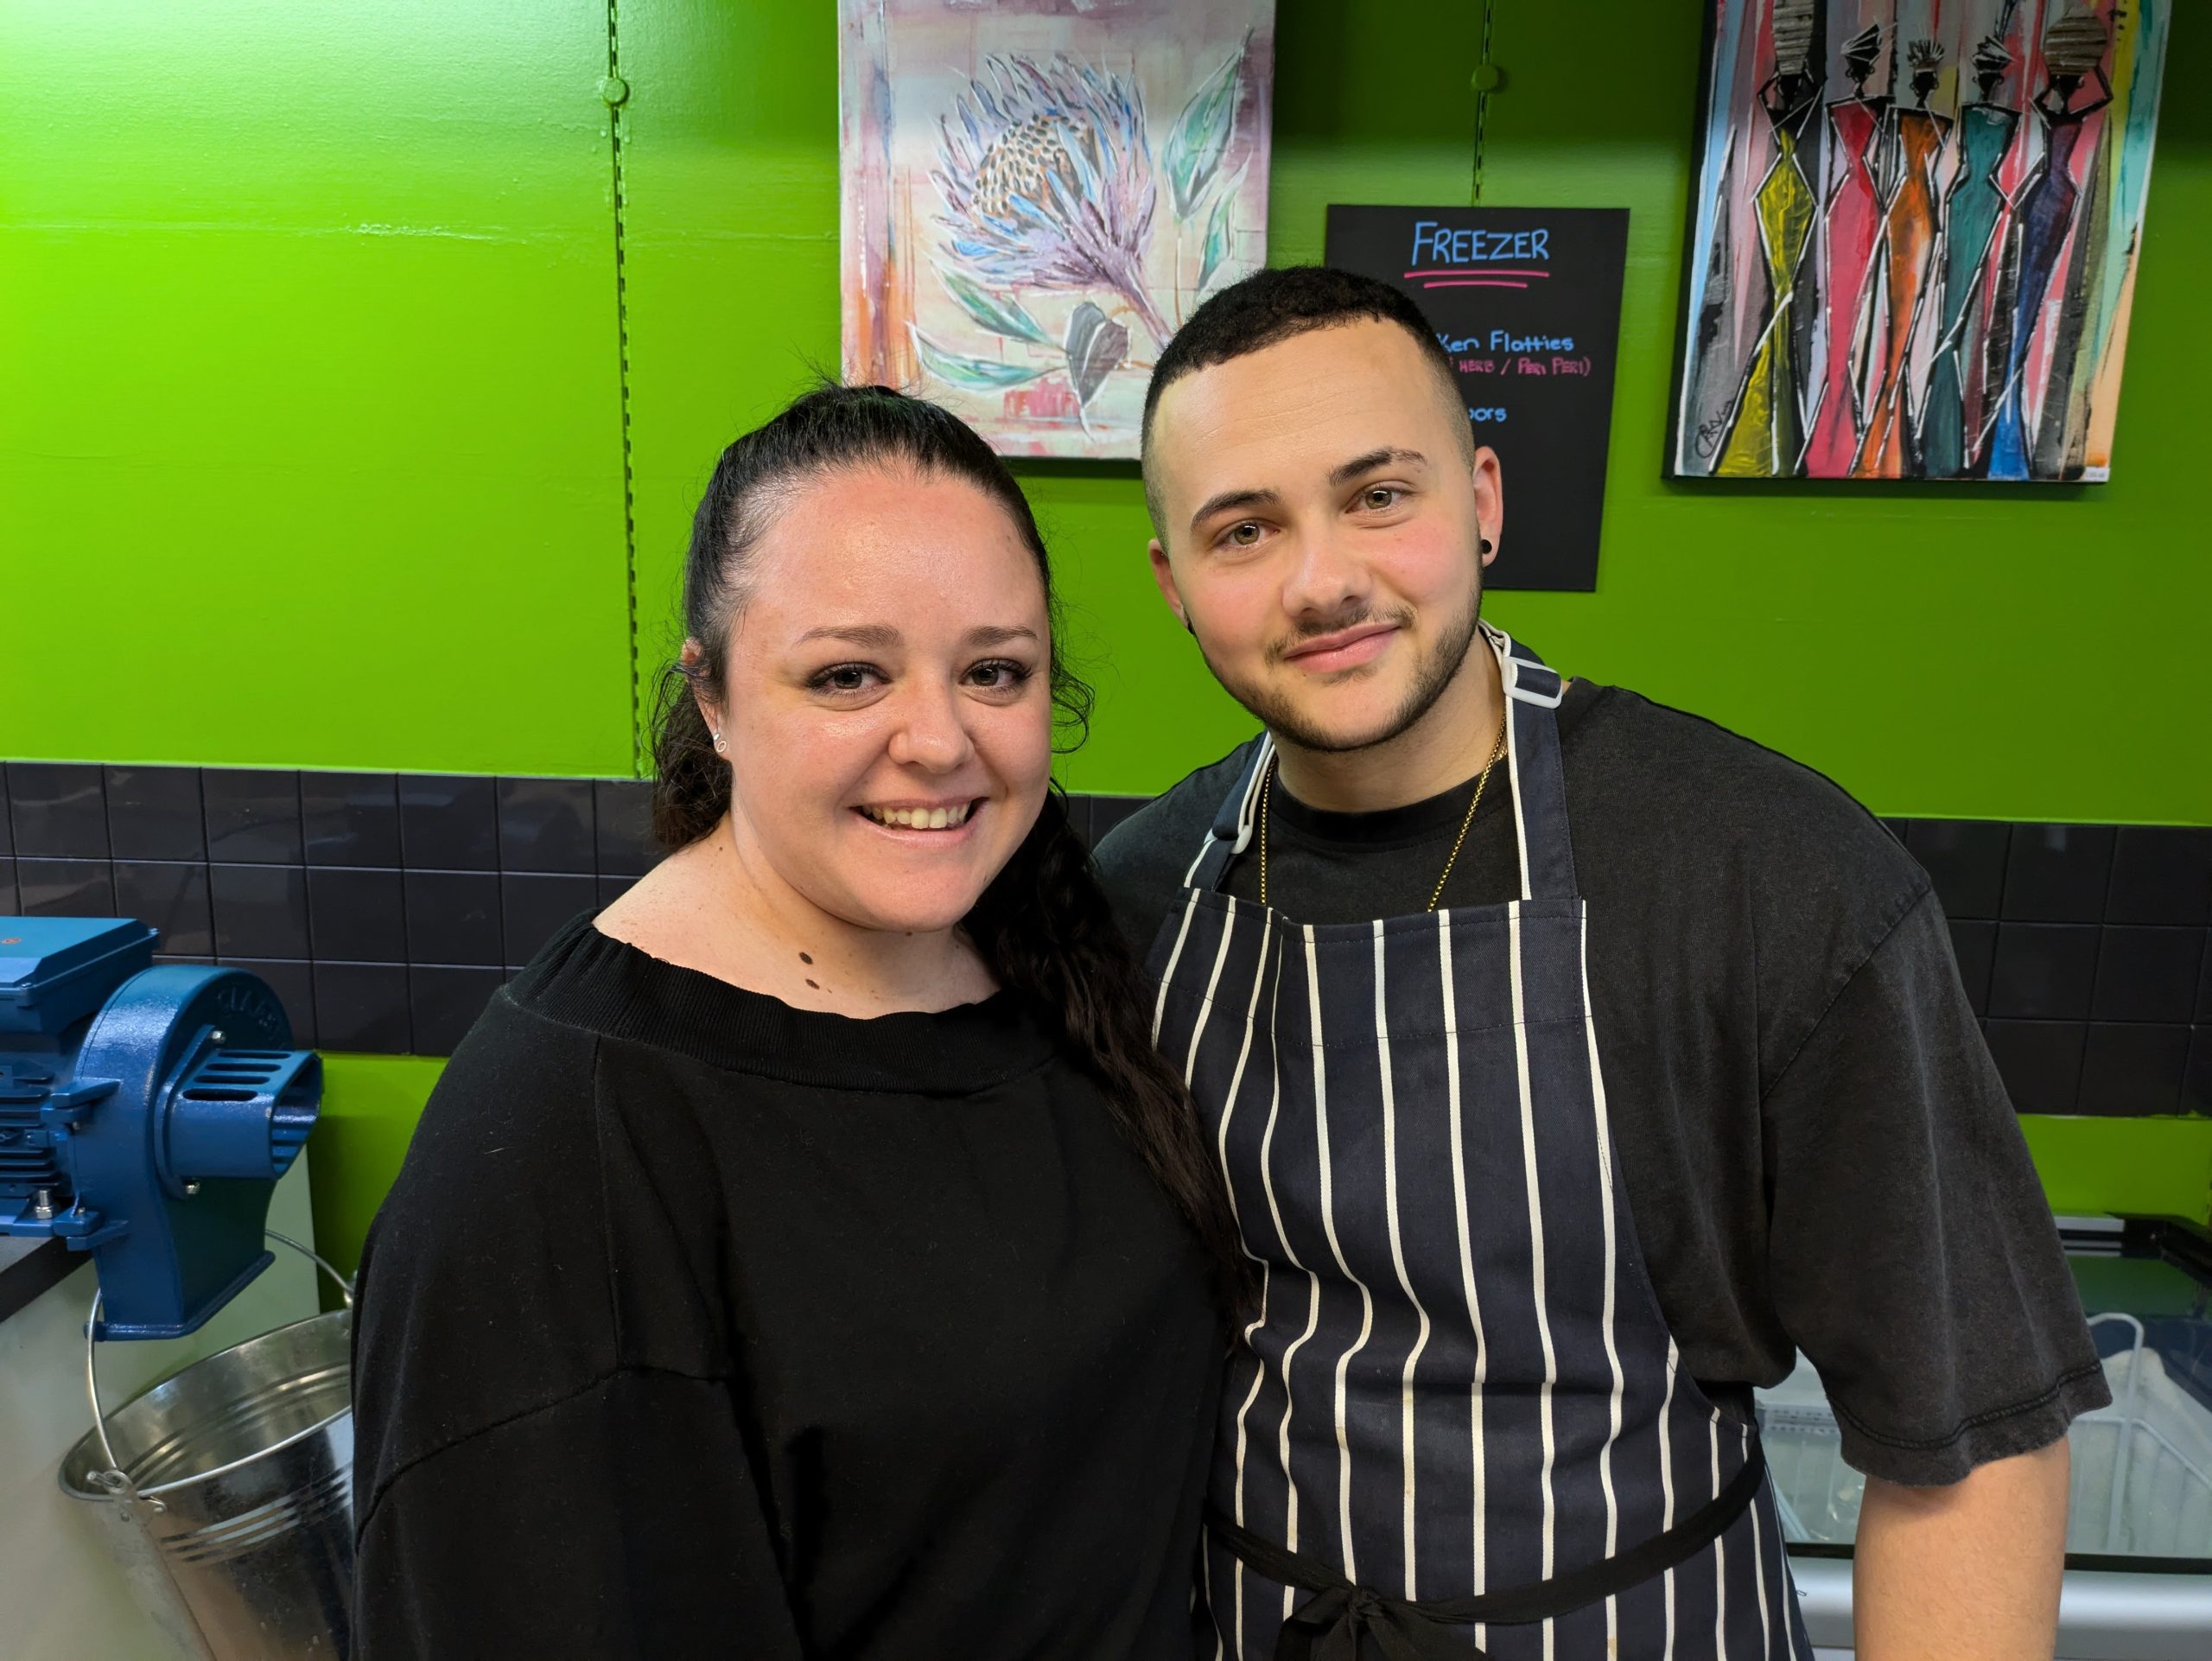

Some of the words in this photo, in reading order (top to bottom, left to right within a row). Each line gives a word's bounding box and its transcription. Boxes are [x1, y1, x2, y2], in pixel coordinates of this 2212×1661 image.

[1411, 220, 1549, 265] FREEZER
[1490, 329, 1574, 353] Flatties
[1459, 359, 1496, 373] HERB
[1468, 407, 1508, 423] ors
